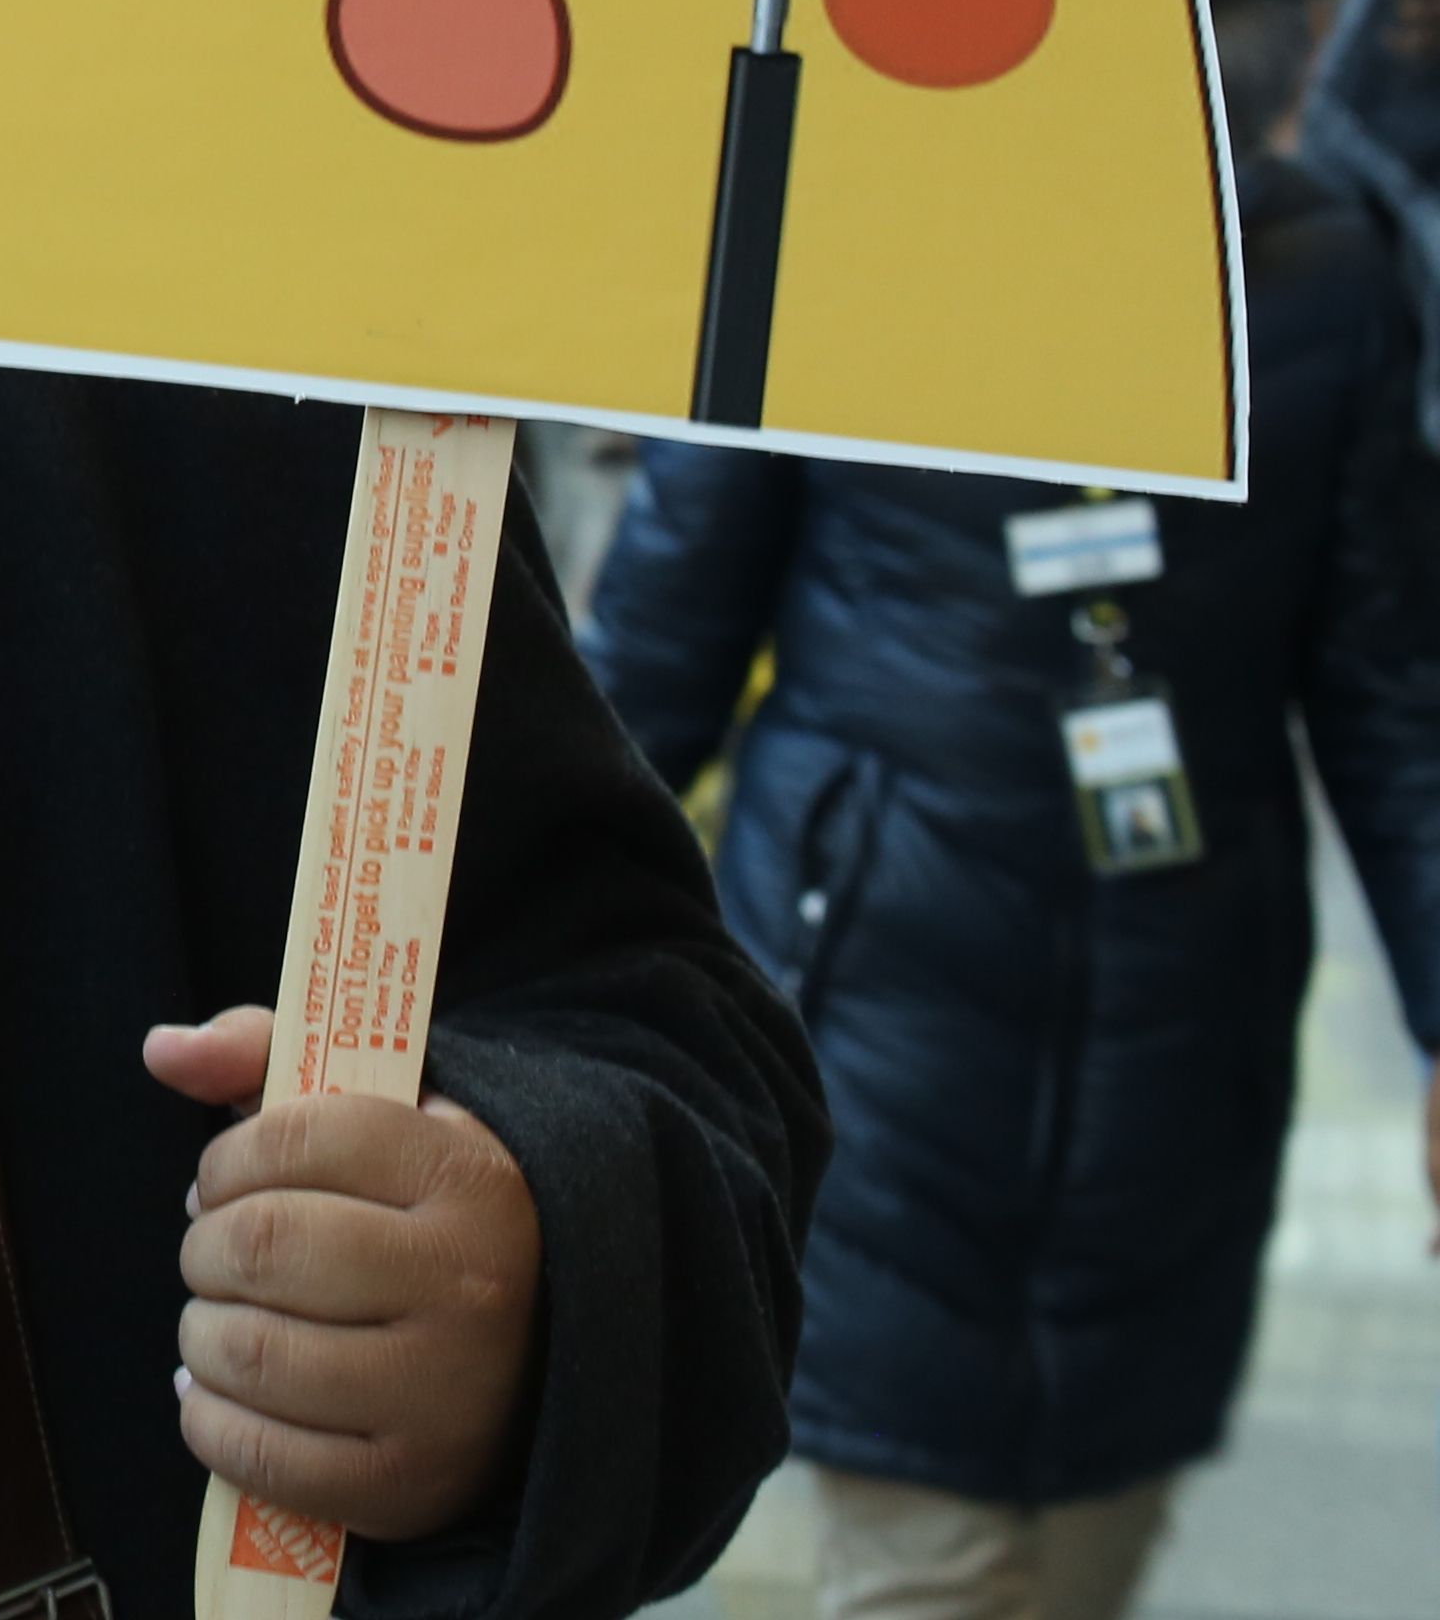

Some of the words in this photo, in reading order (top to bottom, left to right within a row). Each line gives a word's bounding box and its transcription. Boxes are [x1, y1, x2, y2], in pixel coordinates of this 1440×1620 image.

[401, 447, 436, 570] supplies:
[353, 647, 371, 669] at
[384, 575, 427, 685] painting
[341, 676, 367, 728] facts
[377, 687, 405, 752] your
[335, 733, 365, 800] safety
[371, 756, 401, 792] up
[329, 802, 349, 862] paint
[361, 796, 391, 855] pick
[318, 863, 341, 912] lead
[354, 858, 383, 886] to
[313, 916, 335, 957] Get
[342, 891, 382, 972] forget
[332, 977, 370, 1051] Don't
